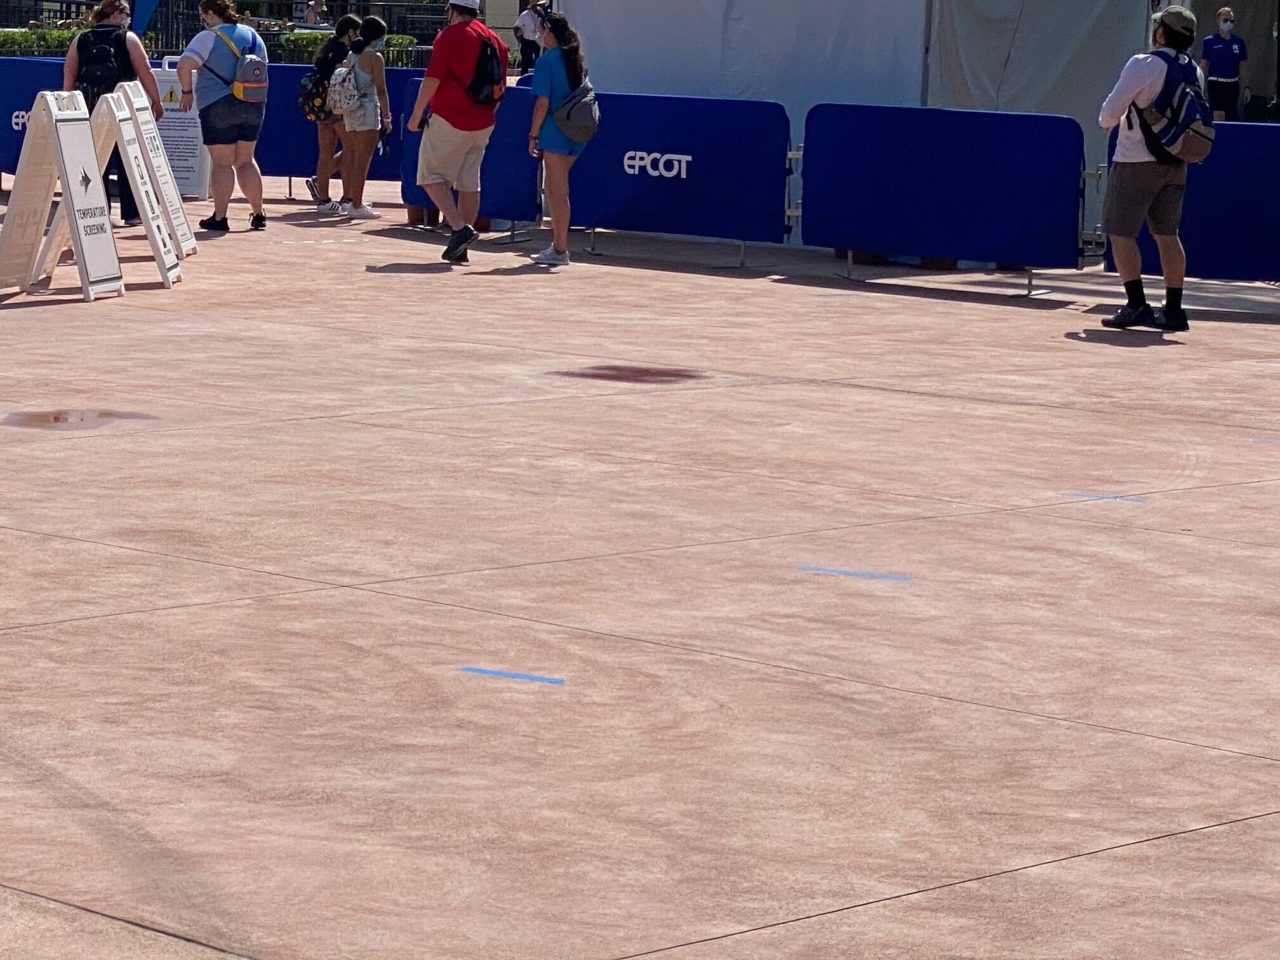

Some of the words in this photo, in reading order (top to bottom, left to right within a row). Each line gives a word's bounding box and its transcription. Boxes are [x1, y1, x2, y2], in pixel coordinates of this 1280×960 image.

[623, 150, 693, 179] EPCOT
[76, 206, 107, 219] TEMPERATURE
[83, 223, 107, 236] SCREENING
